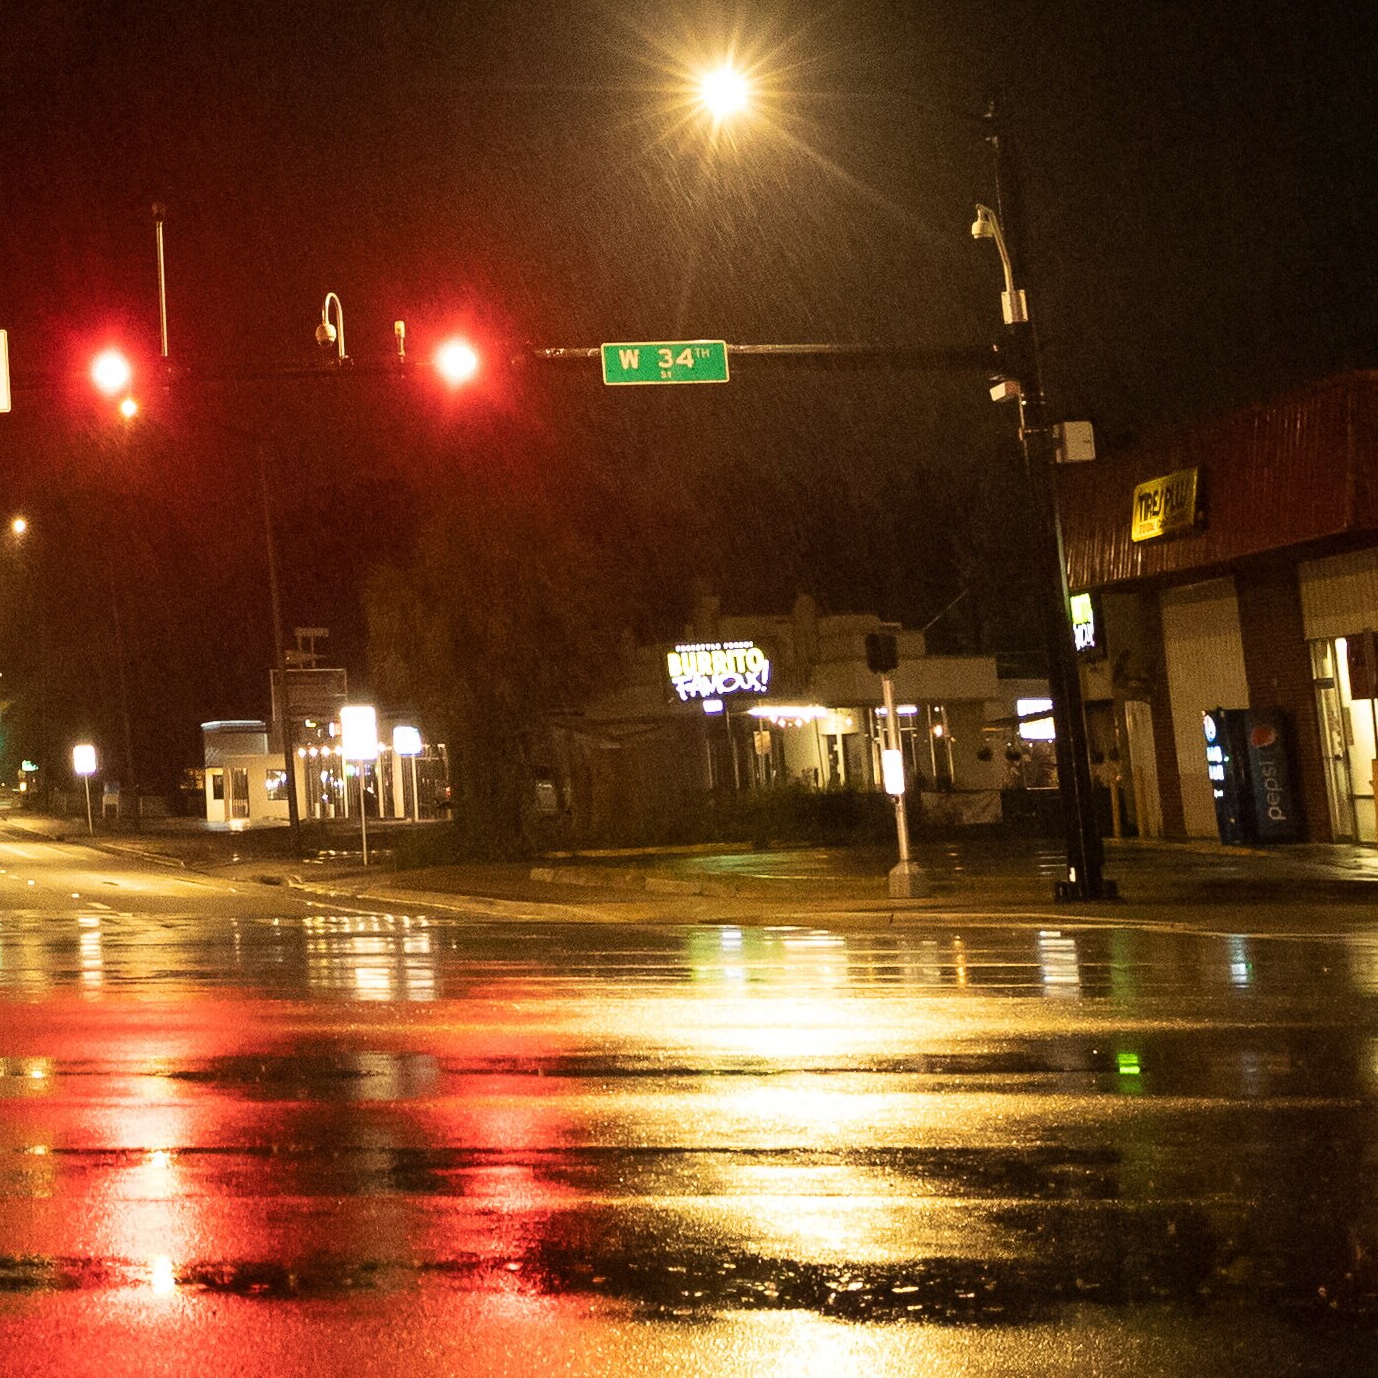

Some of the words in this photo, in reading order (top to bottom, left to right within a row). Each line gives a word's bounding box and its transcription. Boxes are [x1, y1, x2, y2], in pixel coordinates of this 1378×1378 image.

[618, 348, 640, 370] W
[658, 347, 711, 369] 34TH
[667, 647, 765, 678] BURRITO
[1259, 761, 1287, 820] pepsi
